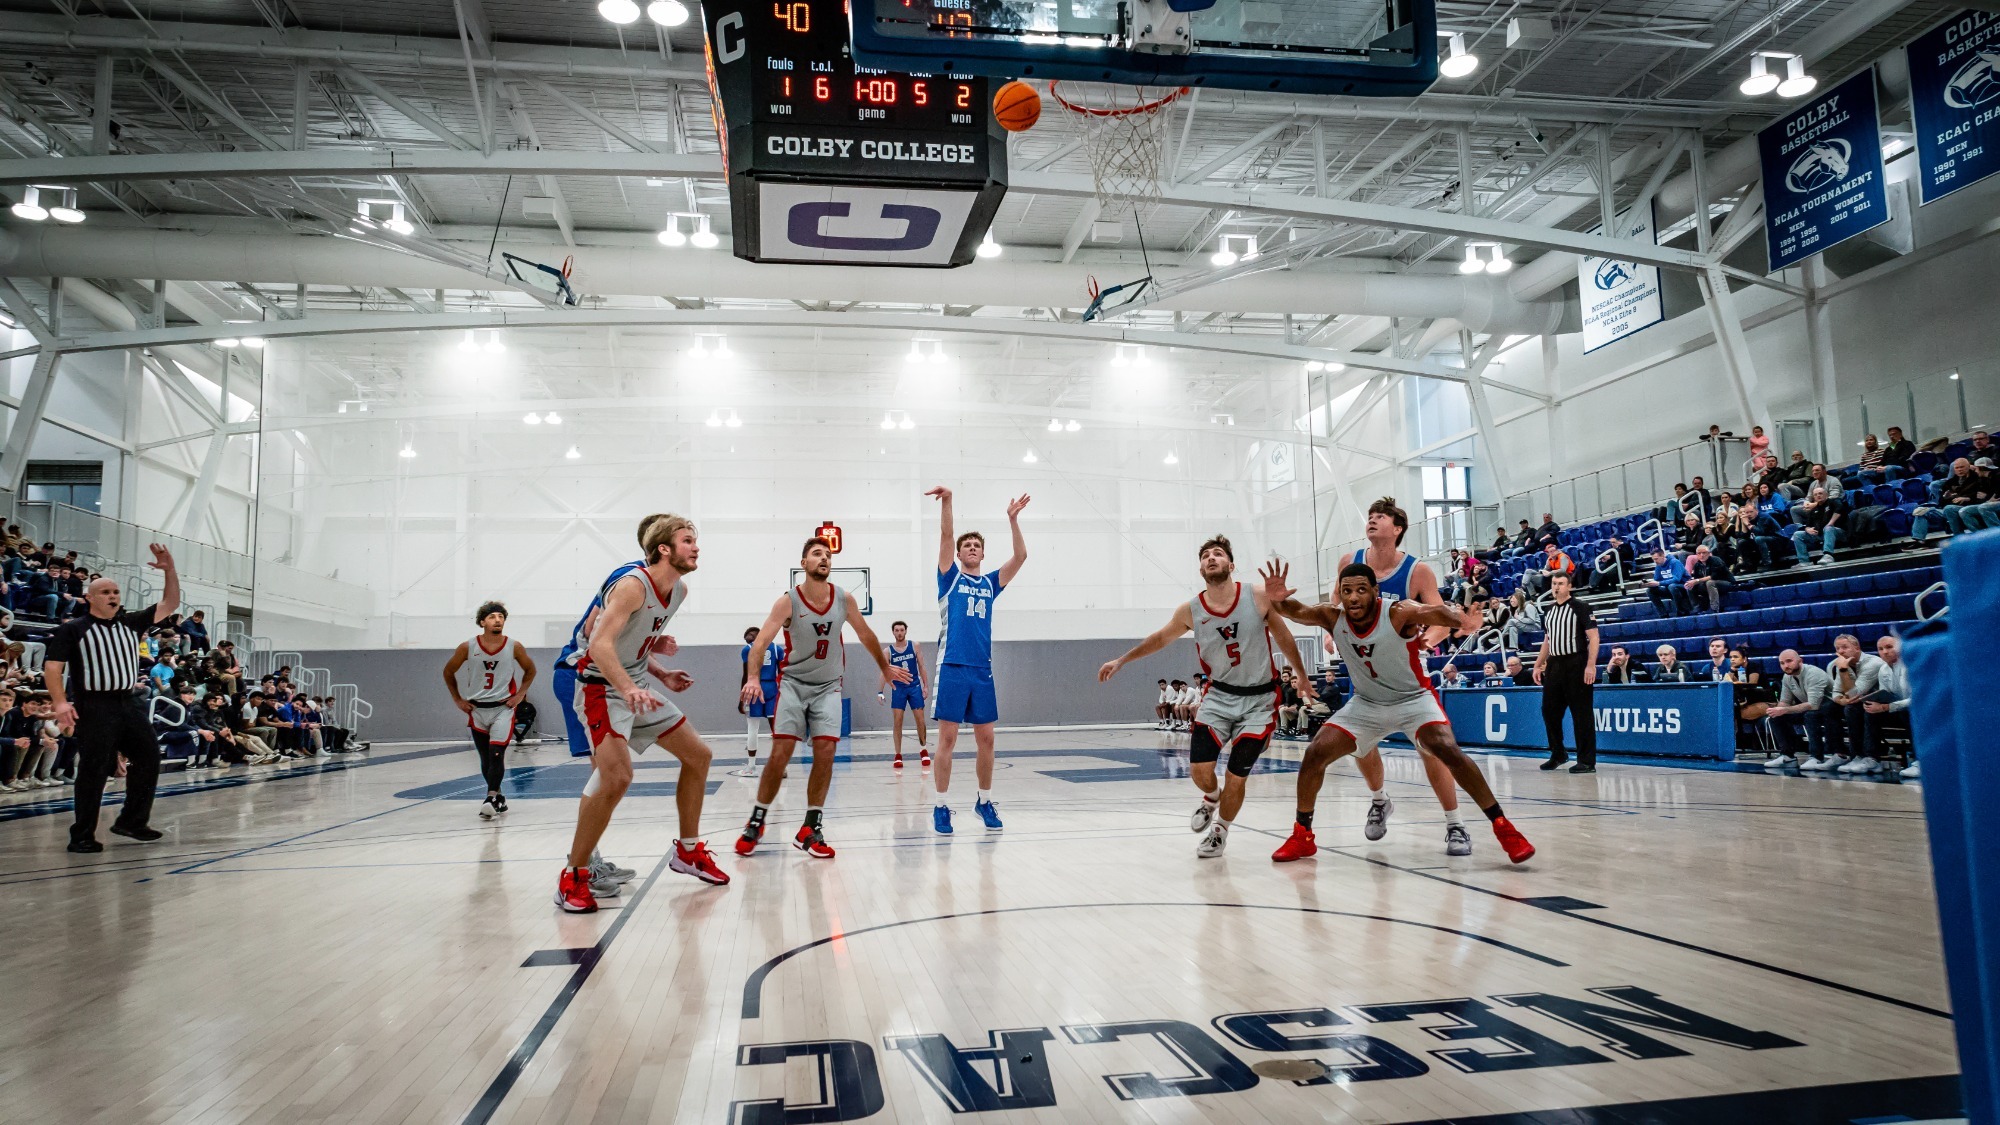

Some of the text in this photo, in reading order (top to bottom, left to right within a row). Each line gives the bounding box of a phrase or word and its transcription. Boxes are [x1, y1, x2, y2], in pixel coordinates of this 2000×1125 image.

[774, 2, 810, 32] 40
[716, 11, 746, 64] C
[767, 56, 794, 70] fouls
[811, 60, 834, 72] t.o.l.
[785, 77, 790, 97] 1
[816, 77, 829, 99] 6
[914, 83, 927, 104] 5
[957, 85, 970, 107] 2
[770, 104, 792, 114] won
[858, 108, 886, 120] game
[951, 113, 972, 124] won
[1786, 95, 1840, 137] COLBY
[1781, 110, 1850, 155] BASKETBALL
[1937, 121, 1971, 145] ECAC
[767, 136, 975, 164] COLBY COLLEGE
[1946, 141, 1968, 157] MEN
[1933, 146, 1983, 175] 1990 1991
[1934, 169, 1956, 185] 1993
[1774, 171, 1872, 226] NCAA TOURNAMENT
[1834, 192, 1865, 211] WOMEN
[1830, 200, 1872, 225] 2010 2011
[1789, 221, 1806, 233] MEN
[1801, 234, 1820, 248] 2020
[1614, 282, 1646, 302] Champions
[1624, 287, 1657, 307] Champions
[1611, 321, 1629, 335] 2005
[966, 596, 987, 619] 14
[815, 640, 829, 659] 0
[1226, 642, 1241, 667] 5
[1364, 660, 1378, 679] 1
[483, 673, 494, 690] 3
[1485, 694, 1508, 742] C
[1594, 708, 1681, 734] MULES
